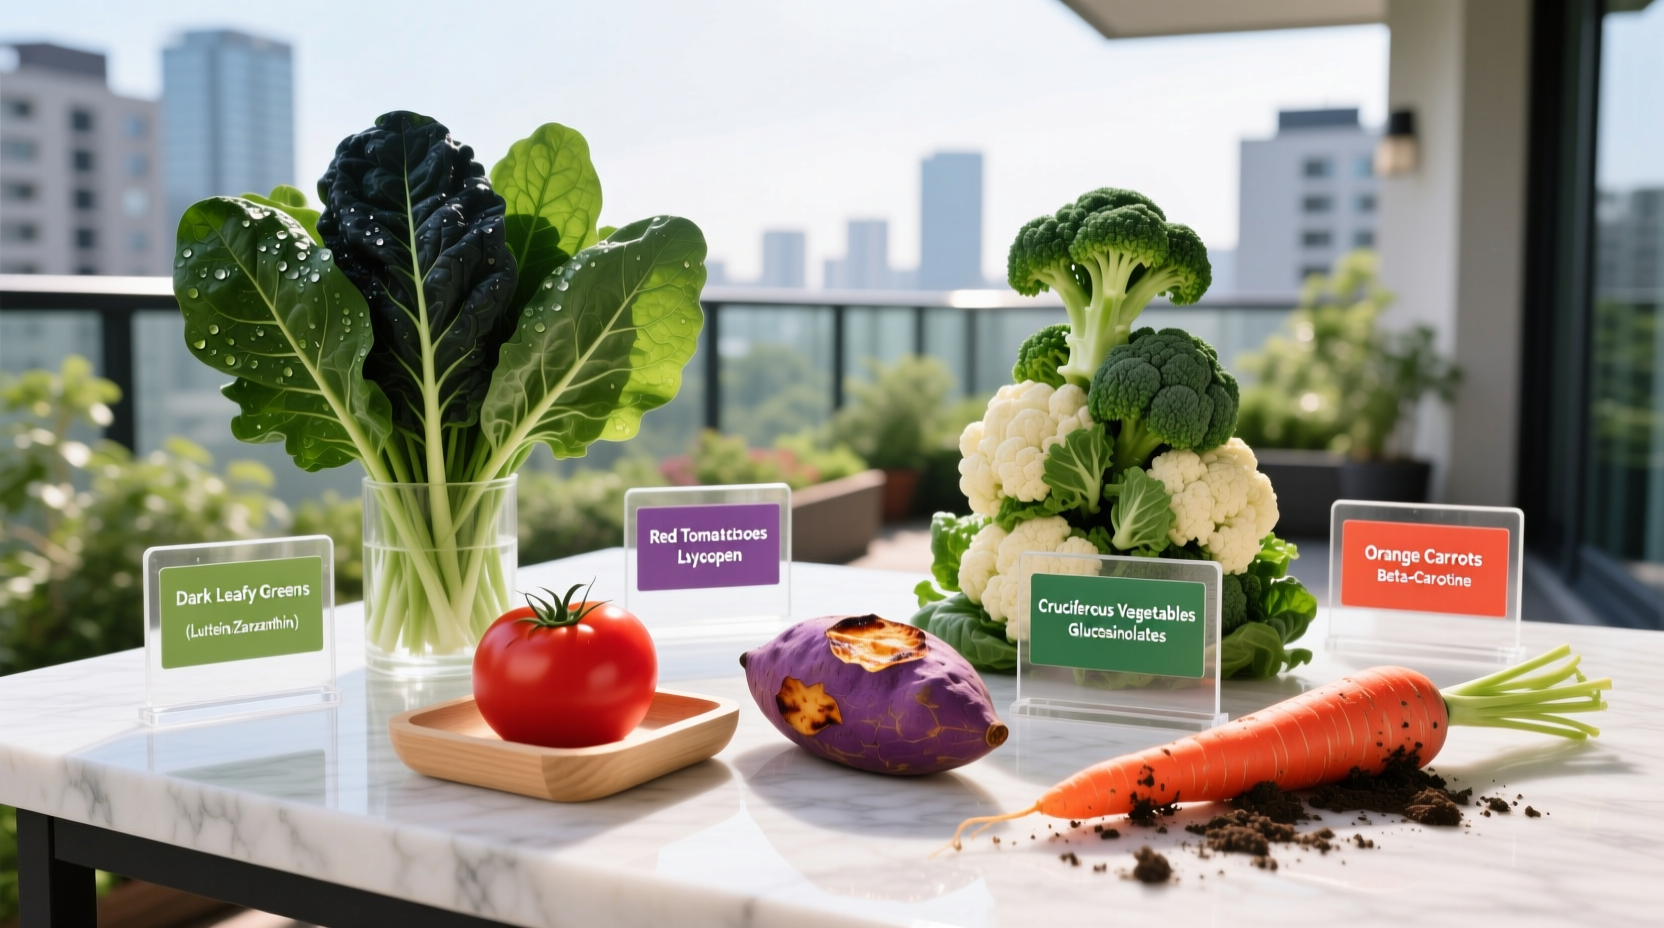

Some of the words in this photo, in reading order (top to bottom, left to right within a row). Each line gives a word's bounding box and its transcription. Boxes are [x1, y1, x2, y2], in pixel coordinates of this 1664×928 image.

[650, 528, 677, 544] Red
[1364, 544, 1421, 567] Orange
[1424, 548, 1483, 567] Carrots
[176, 587, 212, 606] Dark
[216, 585, 257, 605] Leafy
[260, 583, 310, 599] Greens
[1038, 598, 1115, 617] Cruciferous
[1117, 603, 1196, 624] Vegetables
